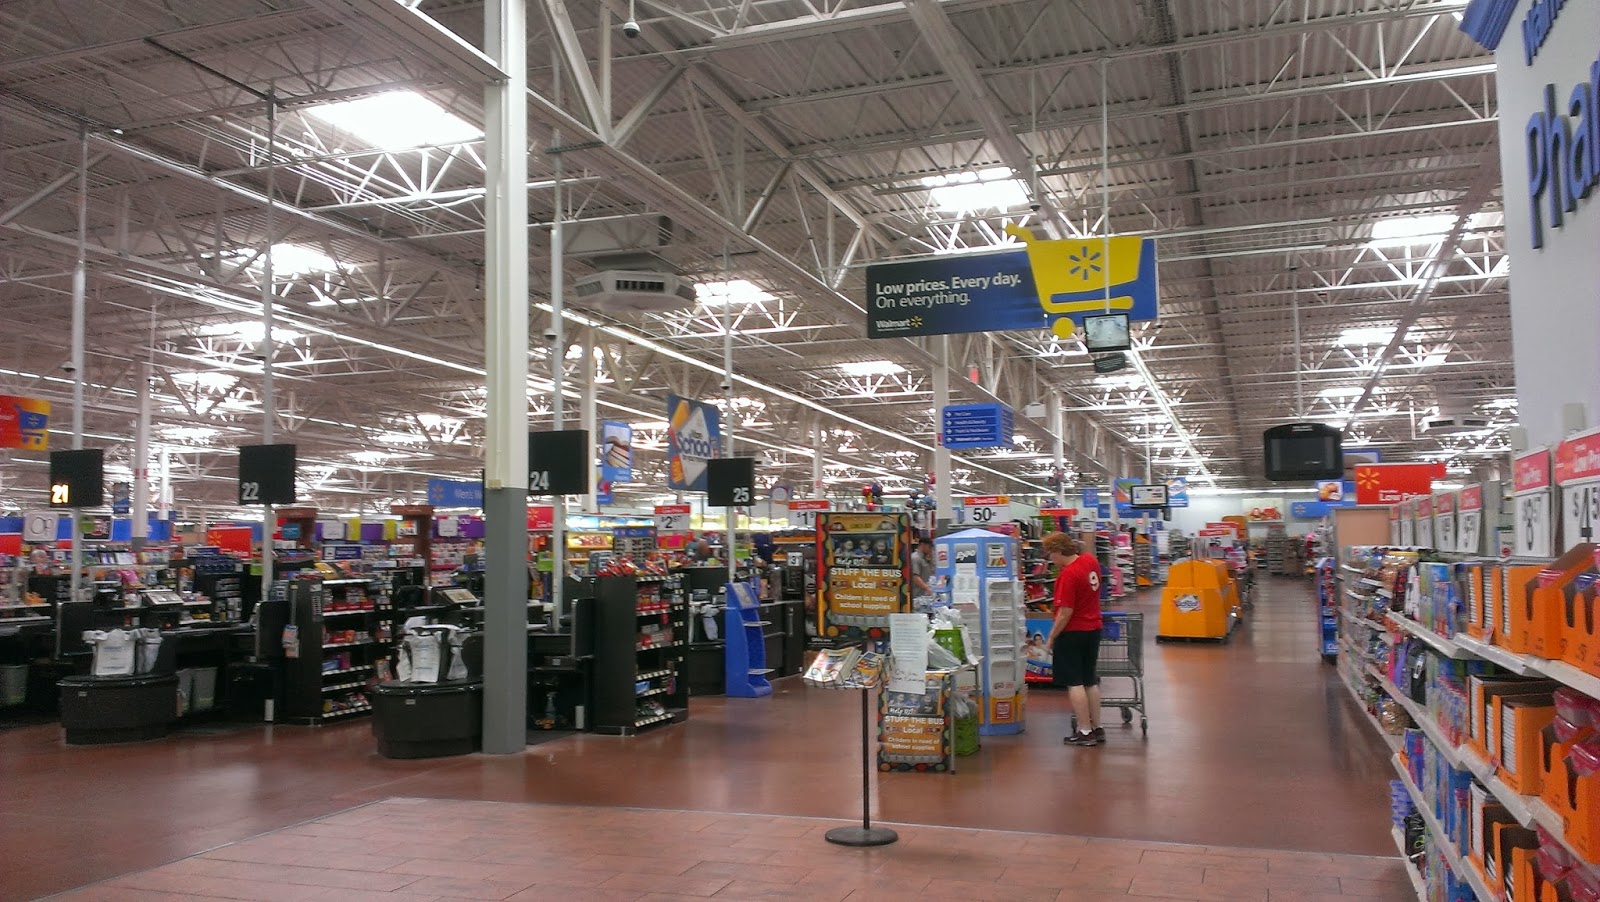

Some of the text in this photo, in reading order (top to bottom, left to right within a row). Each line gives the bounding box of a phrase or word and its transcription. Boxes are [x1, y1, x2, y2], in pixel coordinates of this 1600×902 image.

[876, 272, 1022, 296] Low prices. Every day.
[875, 292, 971, 309] On everything.
[875, 319, 911, 329] Walmart
[530, 470, 549, 491] 24
[51, 484, 69, 503] 21
[241, 481, 260, 501] 22
[732, 487, 750, 503] 25
[830, 567, 903, 578] STUFF THE BUS
[851, 580, 877, 589] Local
[1088, 571, 1100, 592] 9
[911, 716, 927, 724] THE
